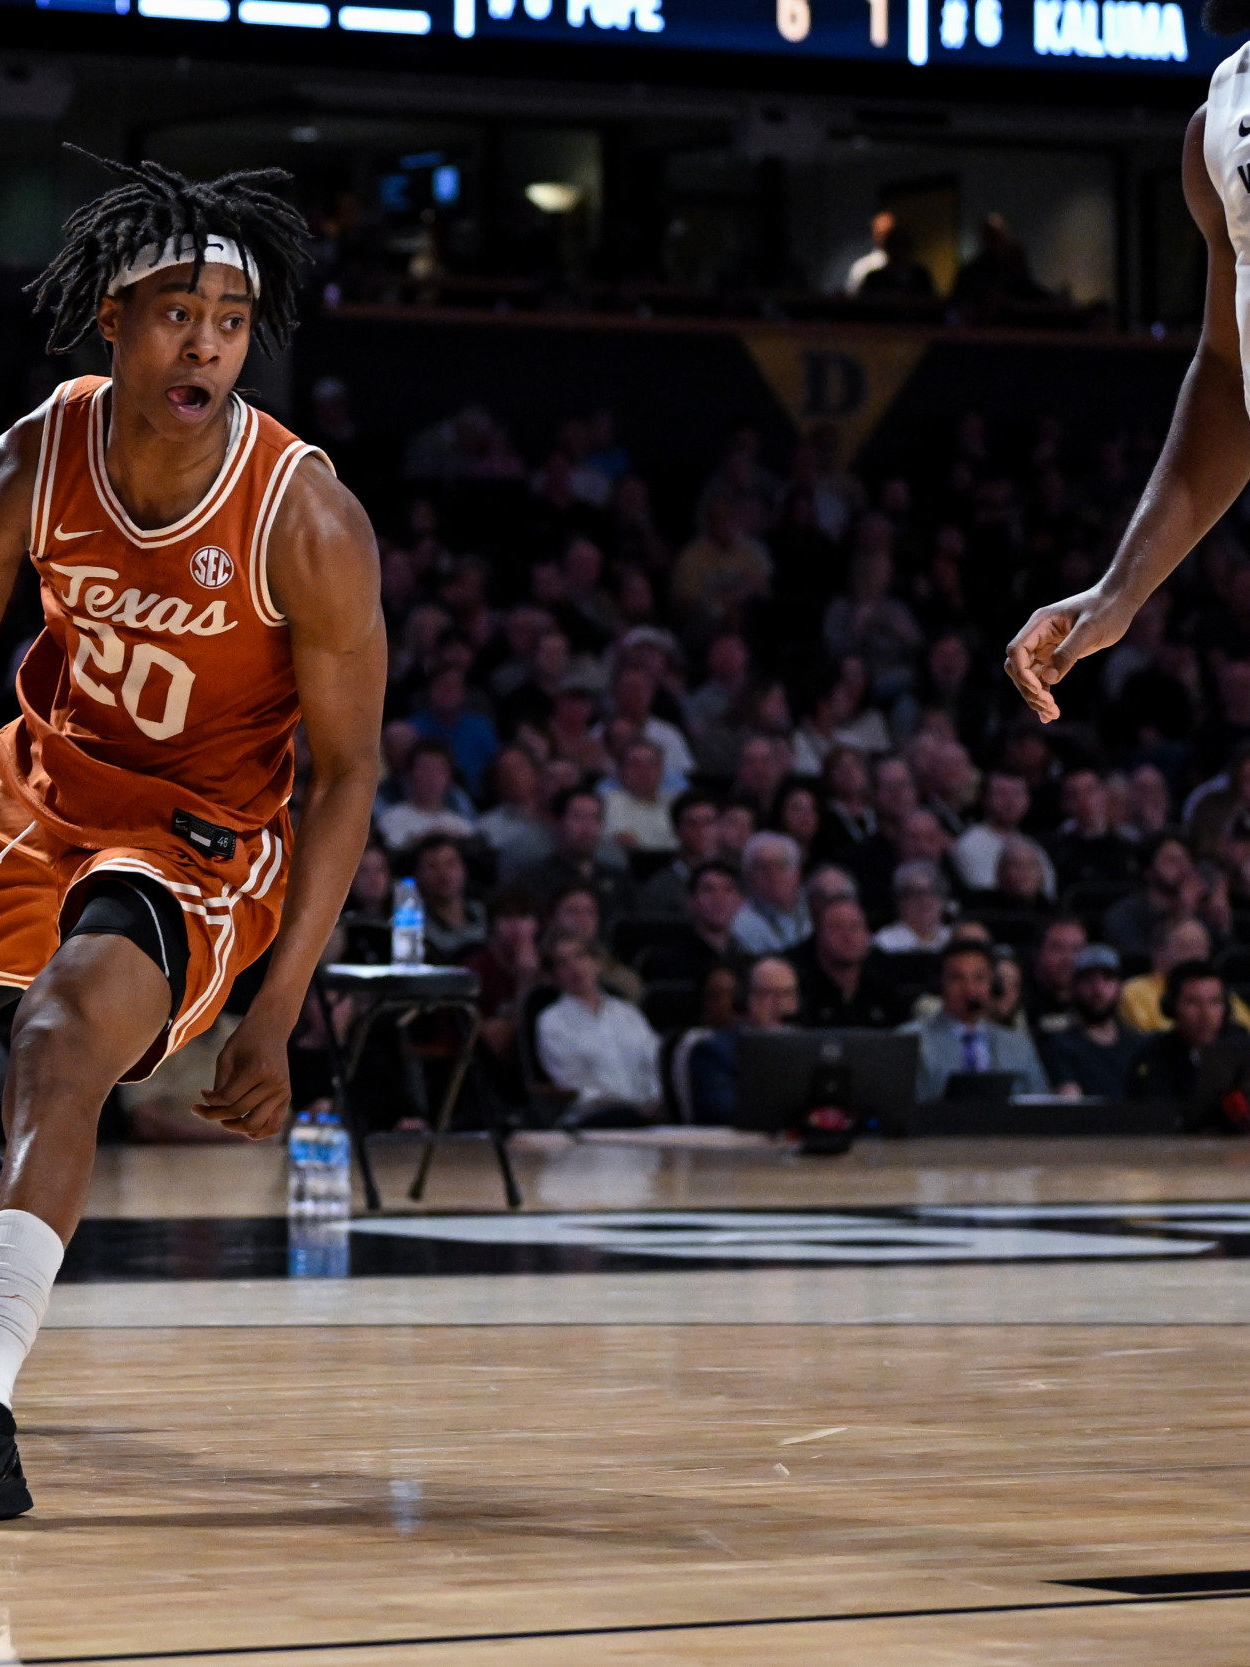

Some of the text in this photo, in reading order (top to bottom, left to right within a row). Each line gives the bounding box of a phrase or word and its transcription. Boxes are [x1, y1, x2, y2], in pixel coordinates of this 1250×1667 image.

[800, 348, 865, 418] D
[50, 562, 238, 636] Texas
[194, 549, 233, 586] SEC
[73, 616, 196, 741] 20
